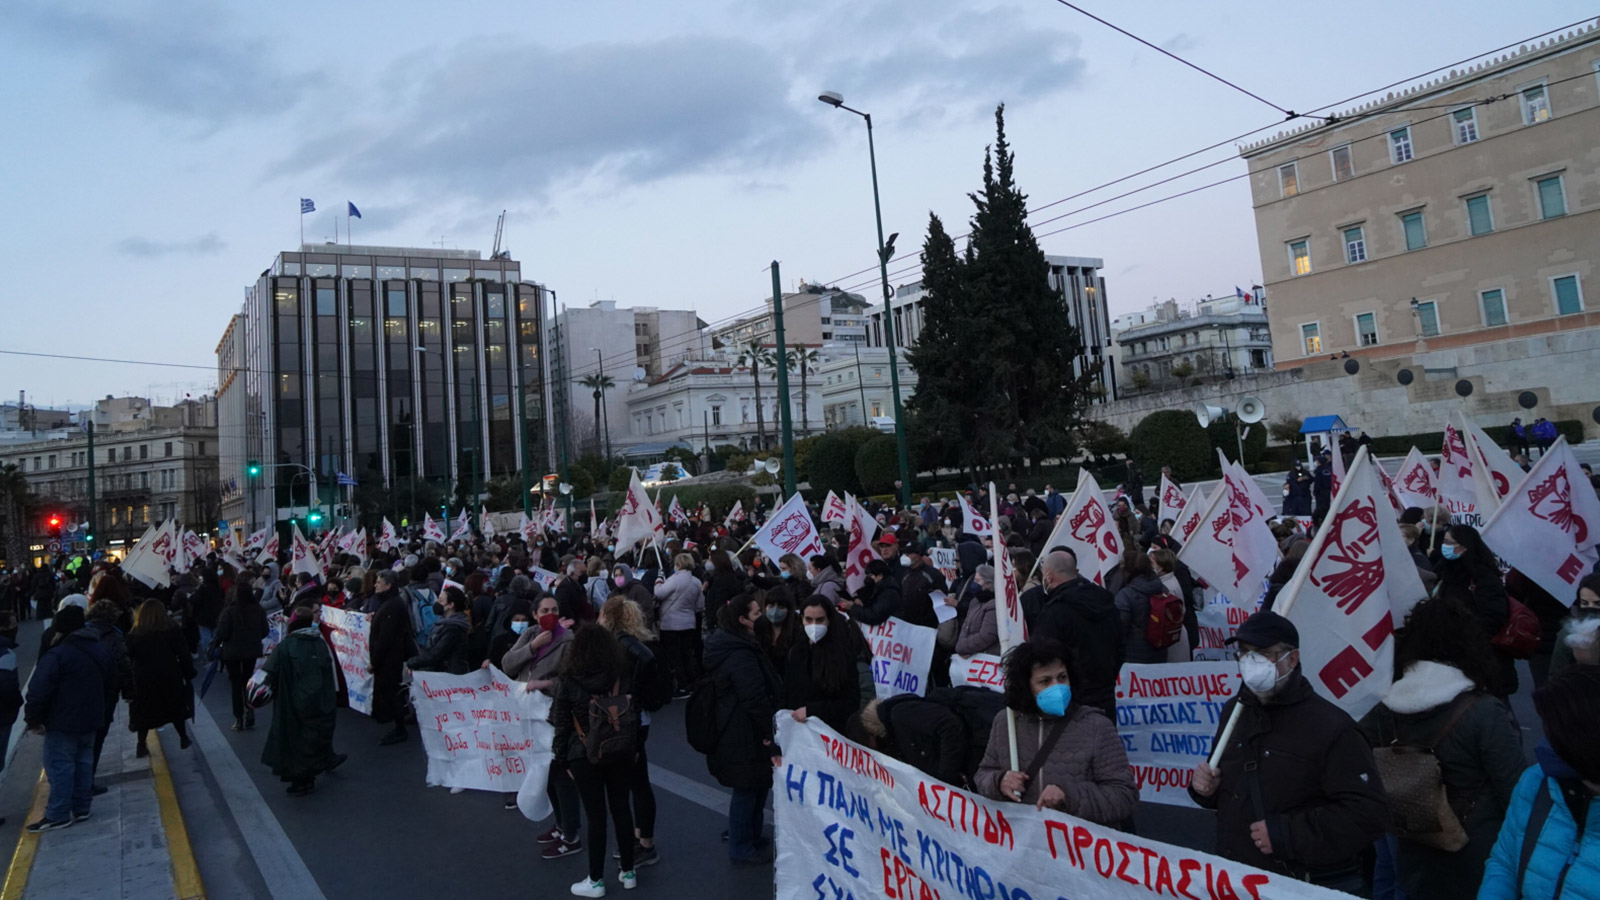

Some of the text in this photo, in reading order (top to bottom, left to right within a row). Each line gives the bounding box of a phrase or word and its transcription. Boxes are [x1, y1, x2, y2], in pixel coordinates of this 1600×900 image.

[846, 549, 875, 578] ΟΓ
[875, 639, 913, 665] ΛΑΩΝ
[1195, 626, 1226, 649] ΠΙΔΑ
[869, 660, 918, 692] ΑΣ ΑΠΟ
[1129, 671, 1232, 701] Απαιτουμε
[1116, 702, 1202, 726] ΟΣΤΑΣΙΑΣ
[787, 764, 807, 805] Η
[817, 771, 873, 831] ΠΑΛΗ
[877, 807, 911, 865] ΜΕ
[917, 781, 1014, 851] ΑΣΠΙΔΑ
[823, 823, 941, 900] ΣΕ ΕΡΓΑ
